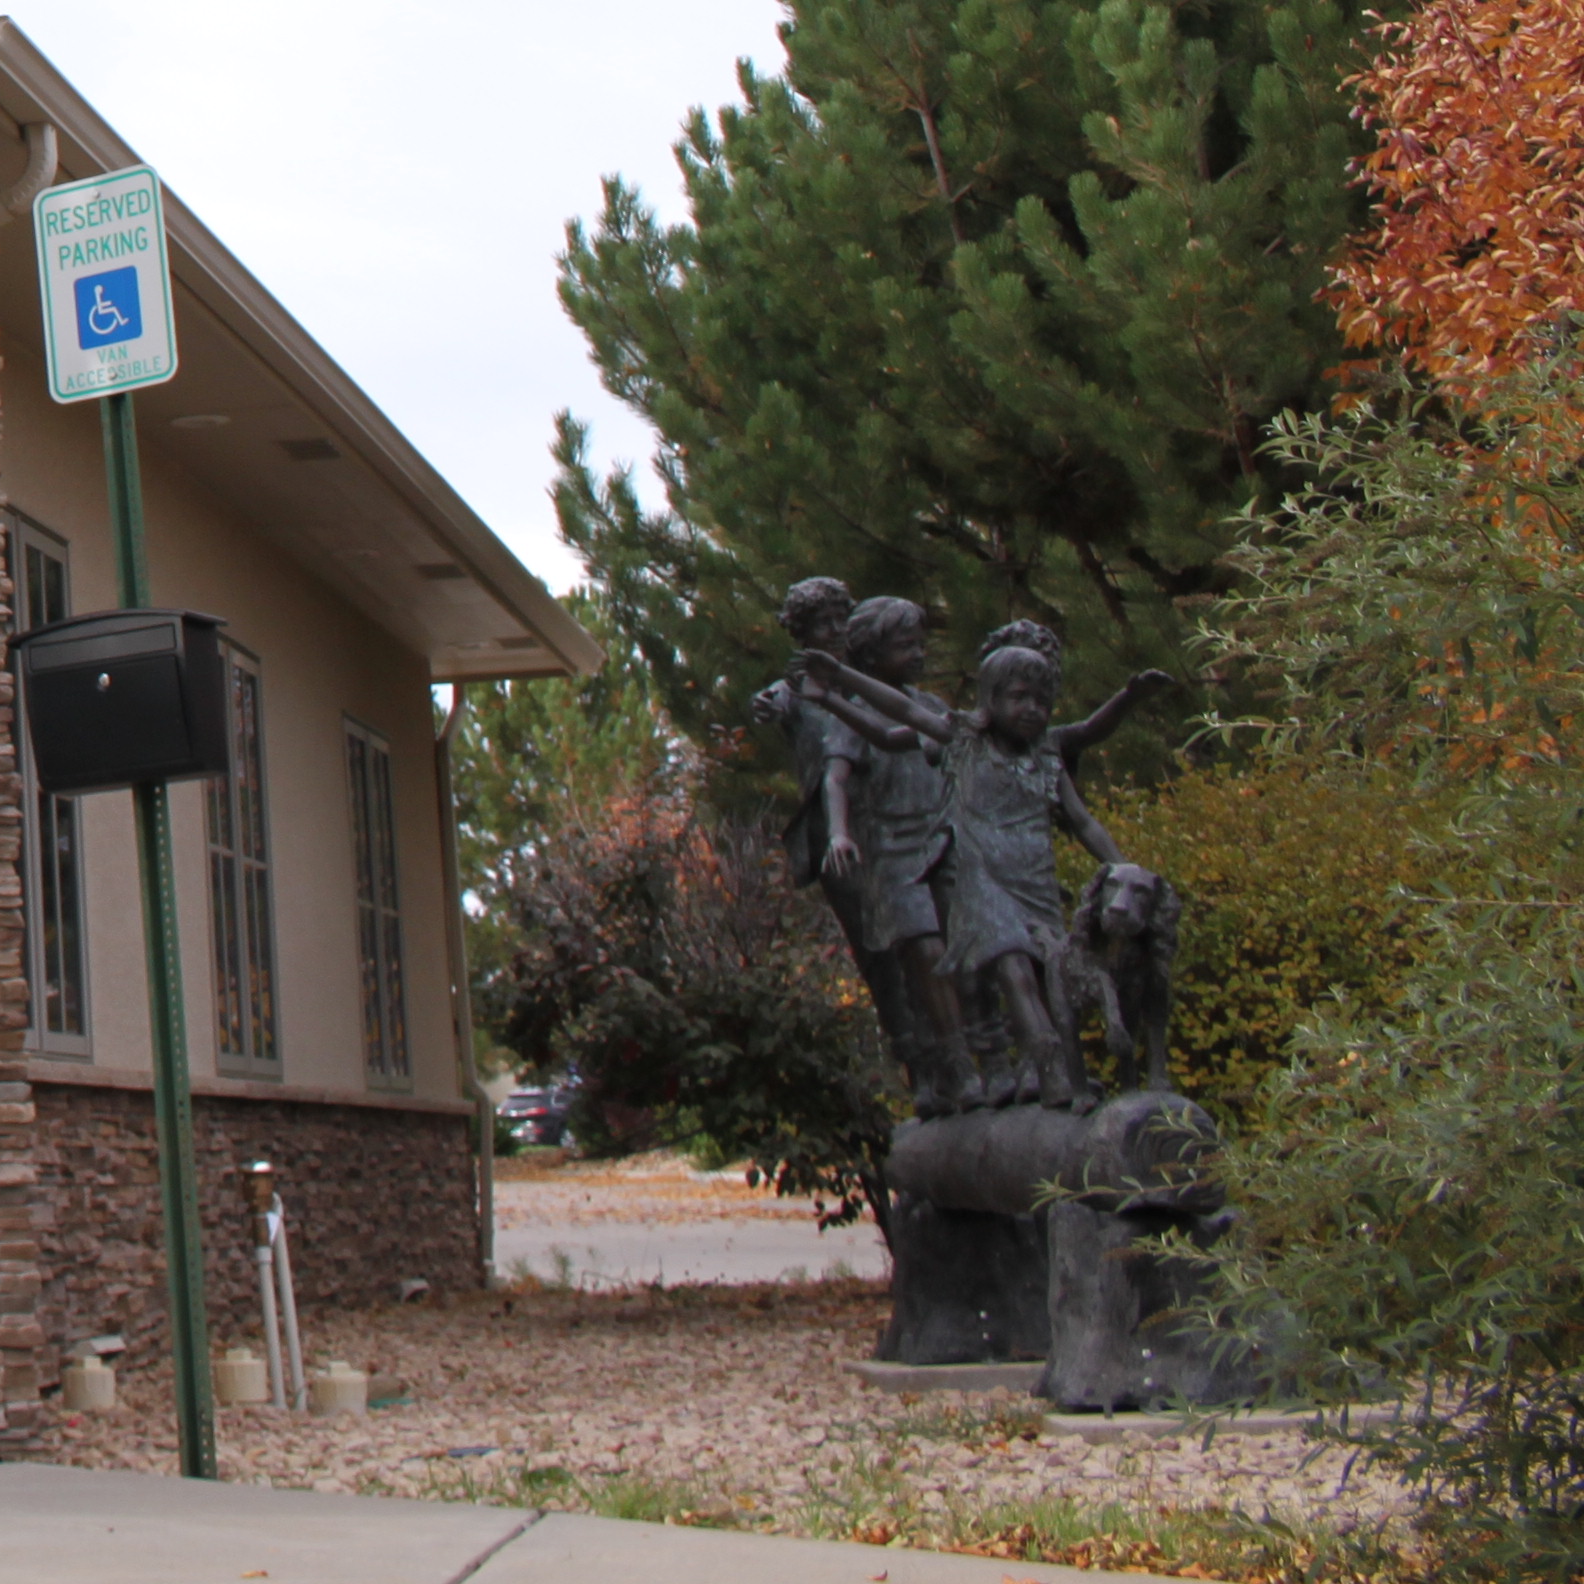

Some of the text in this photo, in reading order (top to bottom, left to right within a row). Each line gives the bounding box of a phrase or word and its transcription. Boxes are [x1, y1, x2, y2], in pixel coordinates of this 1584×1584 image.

[46, 188, 151, 237] RESERVED
[58, 226, 148, 270] PARKING
[97, 345, 128, 363] VAN
